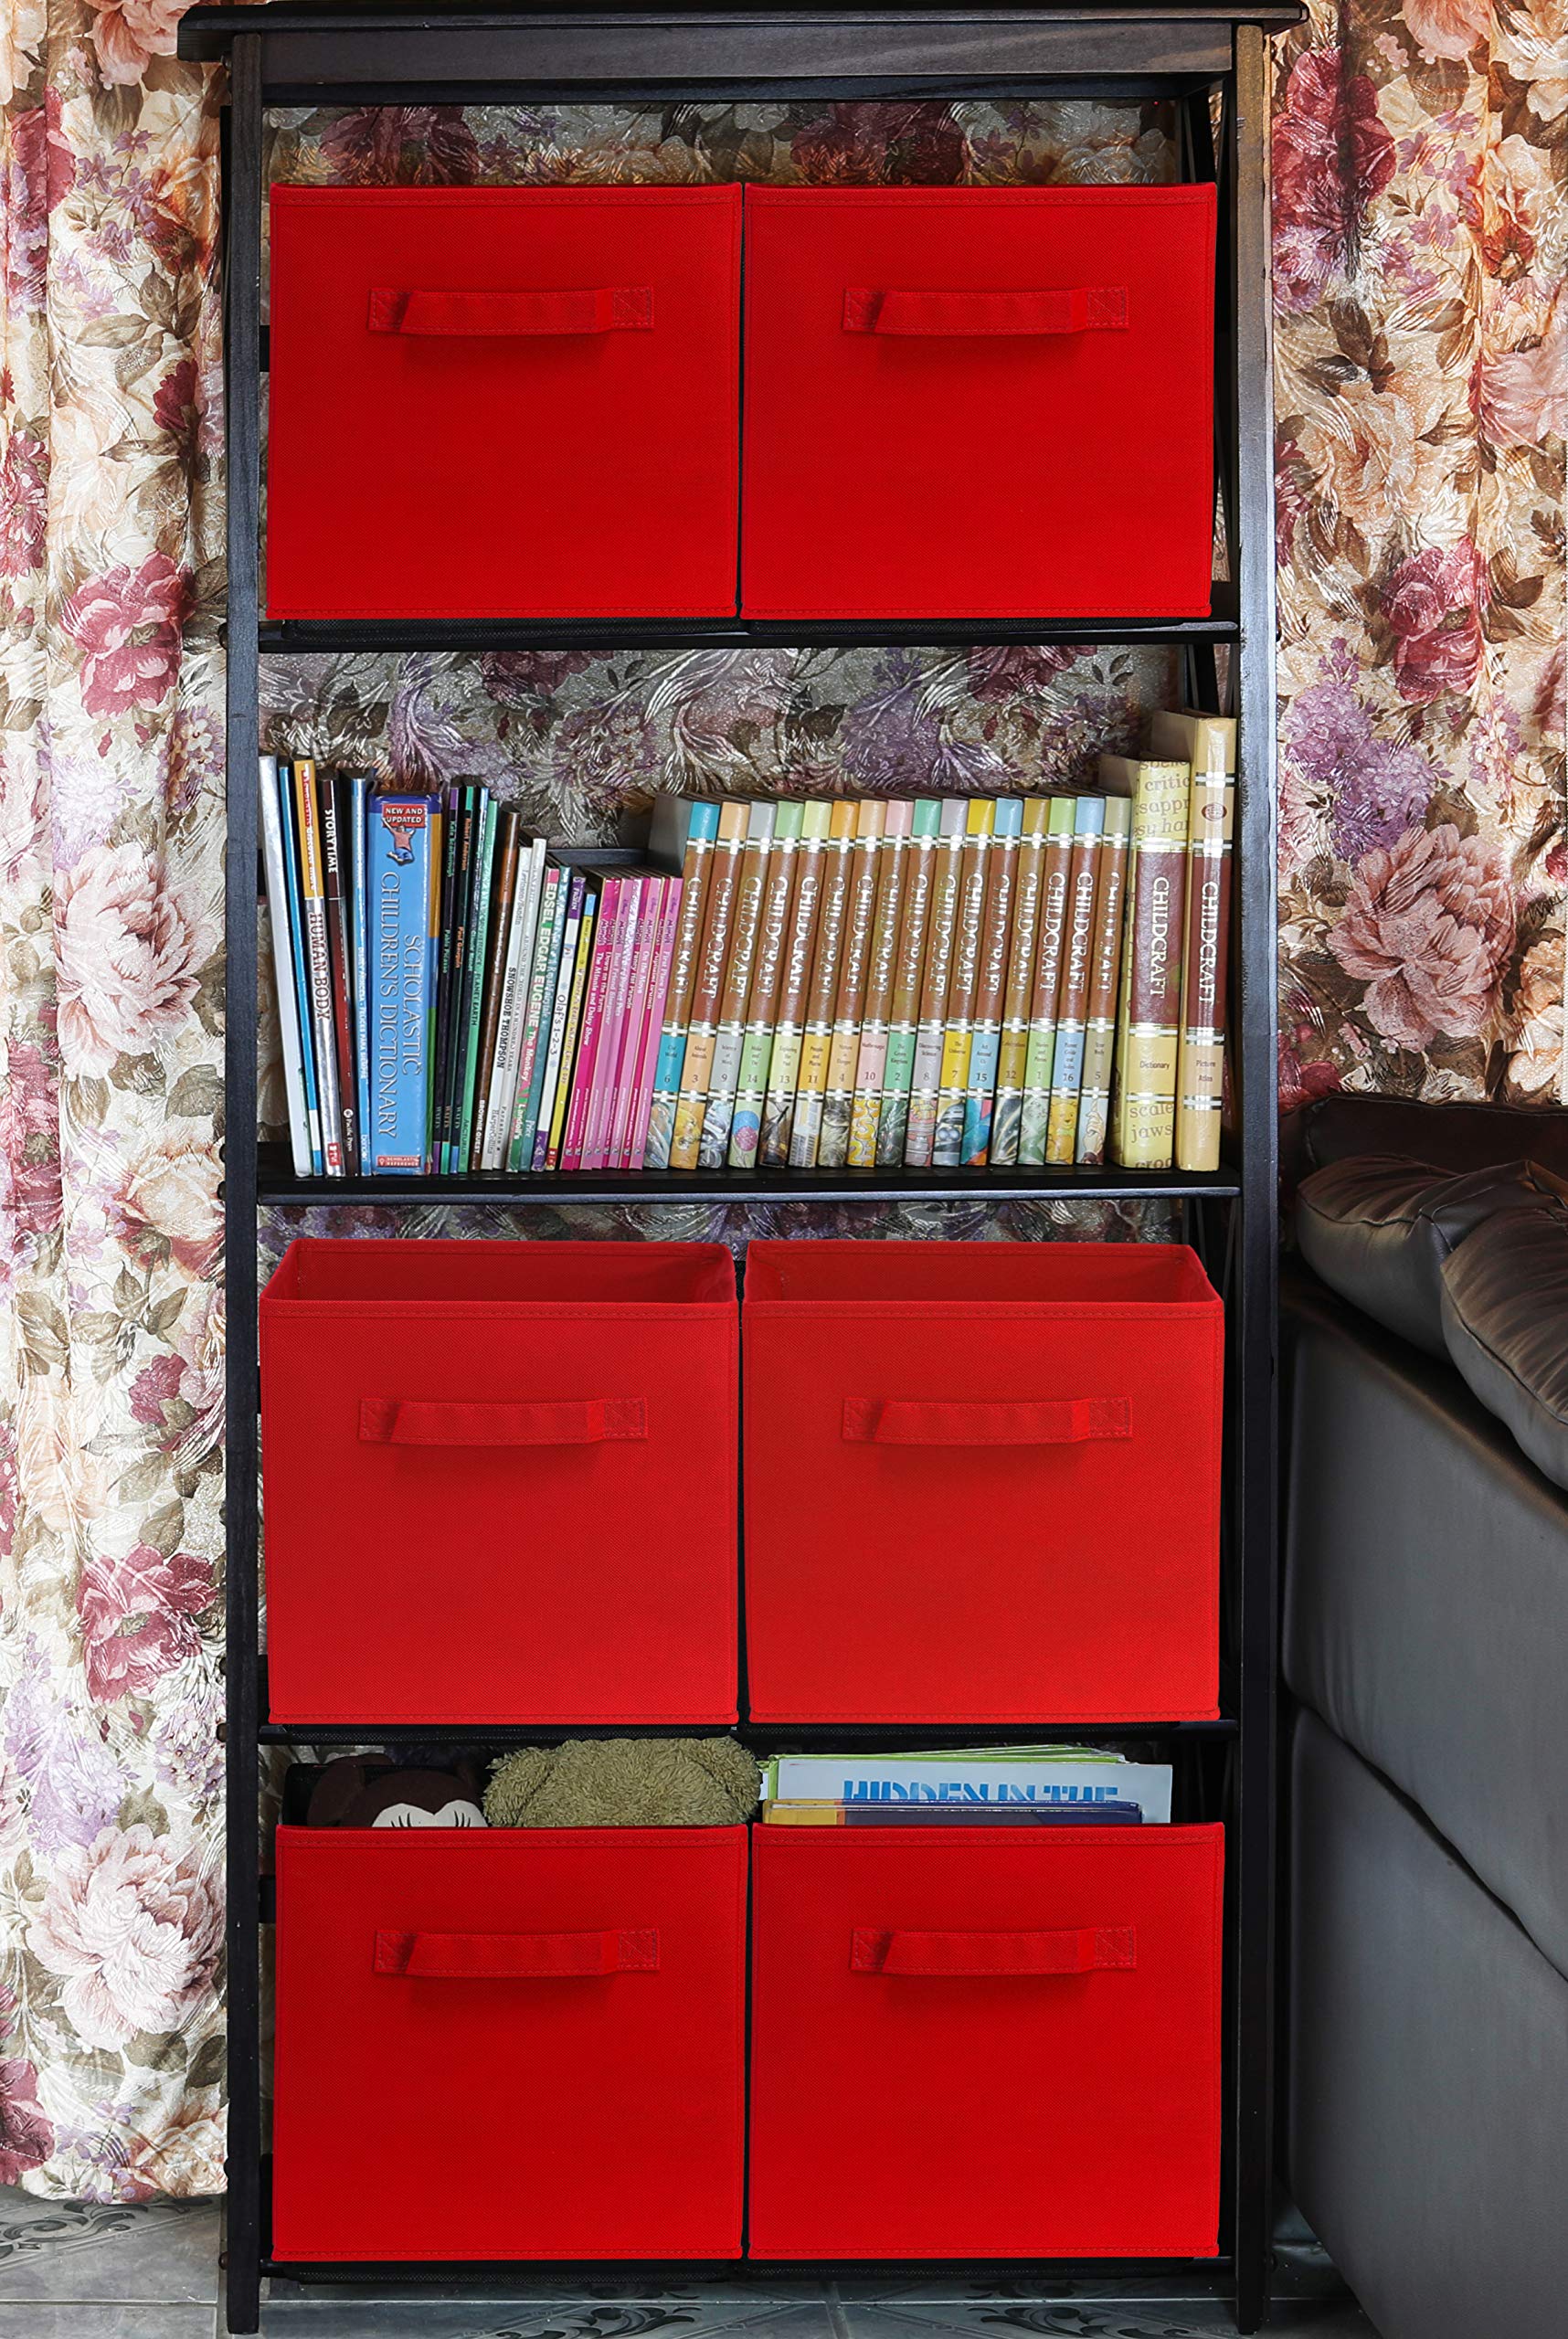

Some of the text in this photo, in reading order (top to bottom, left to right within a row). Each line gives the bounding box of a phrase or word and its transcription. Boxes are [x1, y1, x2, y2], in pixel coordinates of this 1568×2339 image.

[1145, 773, 1190, 792] critic
[386, 816, 422, 824] UPDATED
[306, 827, 314, 865] discover
[324, 810, 338, 873] STORYTIME
[461, 841, 470, 870] Anderson
[570, 887, 580, 910] FROZEN
[702, 877, 733, 999] CHILDCRAFT
[729, 877, 762, 998] CHILDCRAFT
[758, 876, 788, 997] CHILDCRAFT
[788, 876, 819, 994] CHILDCRAFT
[817, 877, 845, 996] CHILDCRAFT
[873, 873, 899, 995] CHILDCRAFT
[900, 873, 927, 991] CHILDCRAFT
[929, 873, 956, 996] CHILDCRAFT
[956, 873, 983, 994] CHILDCRAFT
[983, 873, 1010, 995] CHILDCRAFT
[1012, 873, 1038, 993] CHILDCRAFT
[1040, 872, 1066, 993] CHILDCRAFT
[1067, 872, 1094, 993] CHILDCRAFT
[1150, 875, 1171, 999] CHILDCRAFT
[1197, 880, 1219, 1005] CHILDCRAFT
[442, 948, 450, 974] Picasso
[455, 942, 463, 968] Gauguin
[603, 951, 611, 971] Down
[662, 951, 670, 968] First
[309, 913, 330, 1021] HUMAN BODY
[601, 973, 608, 981] on
[637, 951, 650, 994] On the Move
[659, 968, 668, 987] Place
[521, 883, 557, 1081] EDSEL EDGAR EUGENE The Monkey
[599, 982, 608, 993] the
[609, 968, 619, 990] Friend
[377, 872, 400, 1139] CHILDREN'S DICTIONARY
[402, 935, 423, 1075] SCHOLASTIC
[583, 952, 604, 1046] The Minnie and Daisy Show
[597, 994, 605, 1012] Farm
[657, 988, 665, 1000] Pie
[471, 1002, 480, 1026] EARTH
[496, 967, 516, 1068] SNOWSHOE THOMPSON
[514, 1003, 522, 1011] IN
[550, 995, 568, 1055] Olaf's 1-2-3
[507, 1050, 515, 1072] YEARS
[1139, 1060, 1171, 1070] Dictionary
[664, 1074, 671, 1083] 6
[692, 1074, 699, 1083] 3
[721, 1074, 727, 1082] 9
[747, 1074, 758, 1083] 14
[779, 1074, 790, 1084] 13
[808, 1074, 818, 1084] 11
[839, 1074, 844, 1083] 4
[864, 1072, 875, 1081] 10
[923, 1073, 929, 1081] 8
[952, 1070, 958, 1078] 7
[976, 1074, 987, 1082] 15
[1005, 1071, 1016, 1079] 12
[1063, 1074, 1074, 1082] 16
[1095, 1071, 1101, 1080] 5
[514, 1104, 526, 1139] Landoll's
[1129, 1103, 1173, 1118] scale
[344, 1118, 353, 1137] Pacific
[473, 1099, 485, 1154] BROWNIE QUEST
[487, 1108, 499, 1154] HarperCollins
[524, 1119, 535, 1138] Price
[1130, 1124, 1172, 1143] jaws
[843, 1780, 989, 1801] HIDDEN
[998, 1783, 1035, 1801] IN
